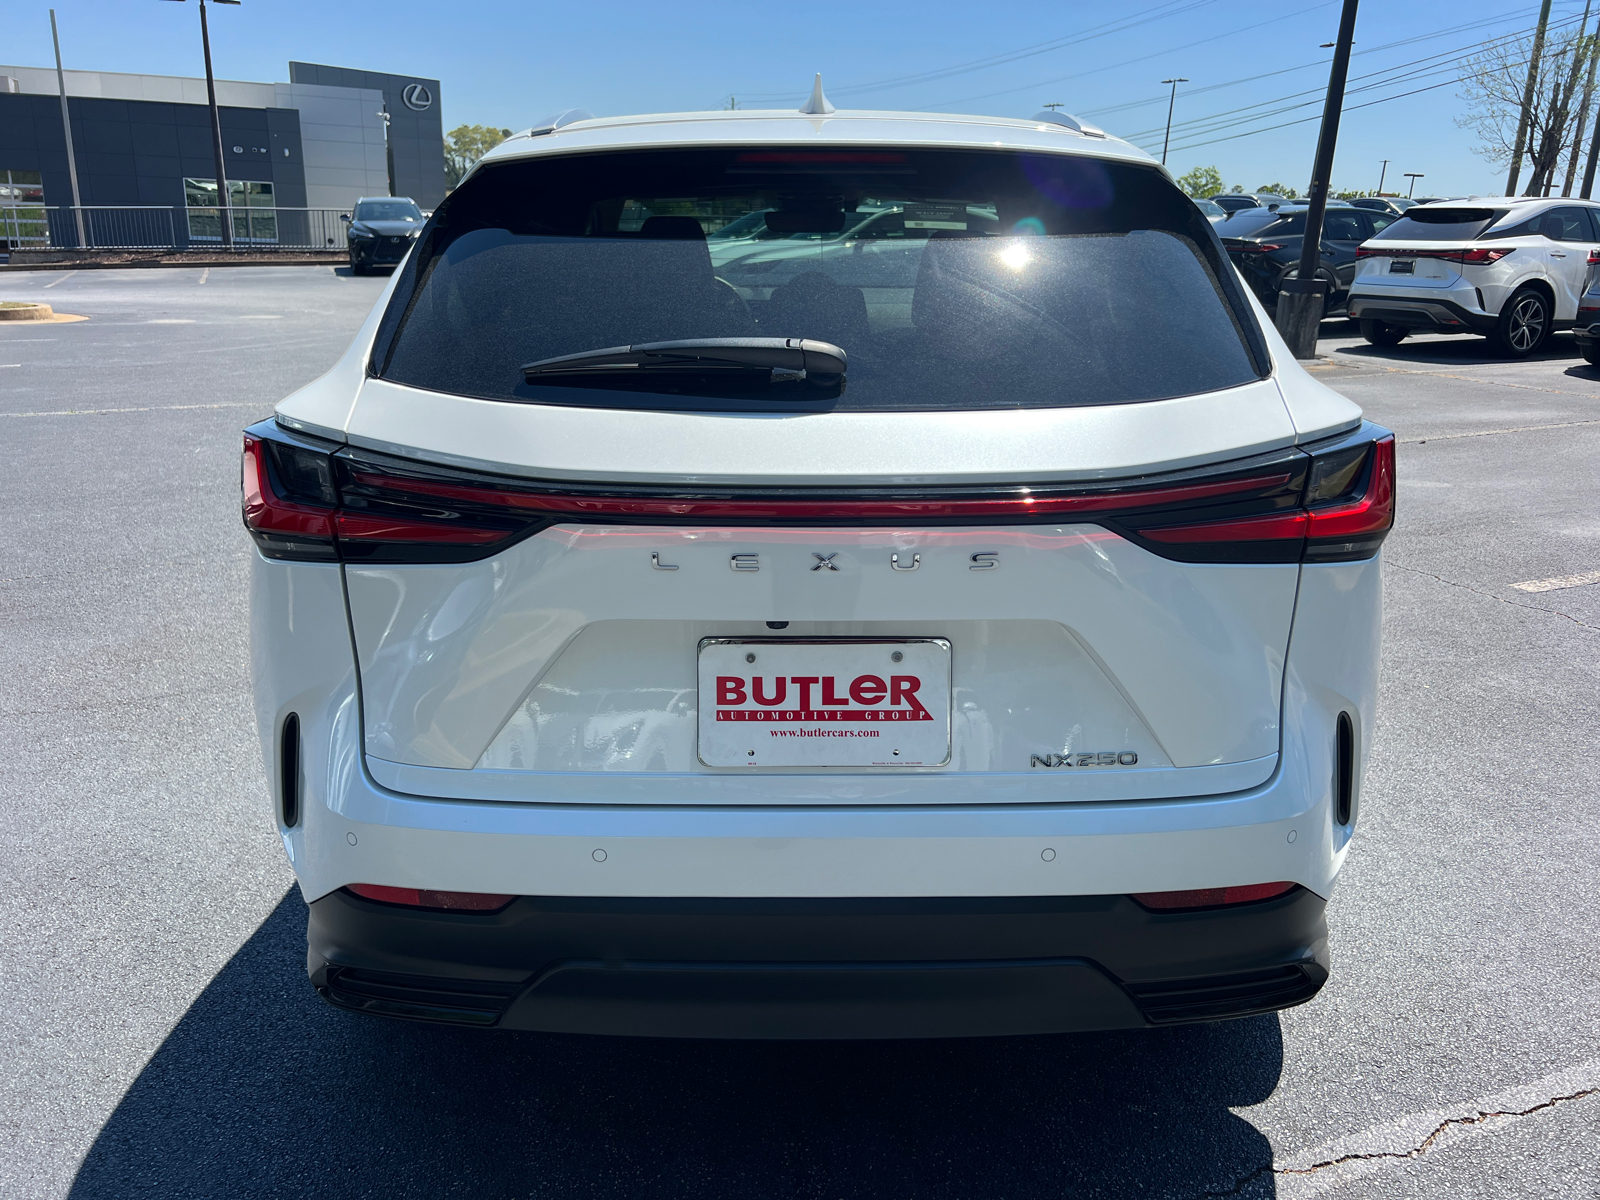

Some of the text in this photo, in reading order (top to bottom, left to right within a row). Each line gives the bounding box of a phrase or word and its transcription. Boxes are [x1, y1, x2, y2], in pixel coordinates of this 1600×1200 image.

[651, 552, 1000, 572] LEXUS
[717, 711, 926, 720] AUTOMOTIVE GROUP
[770, 727, 880, 738] www.butlercars.com
